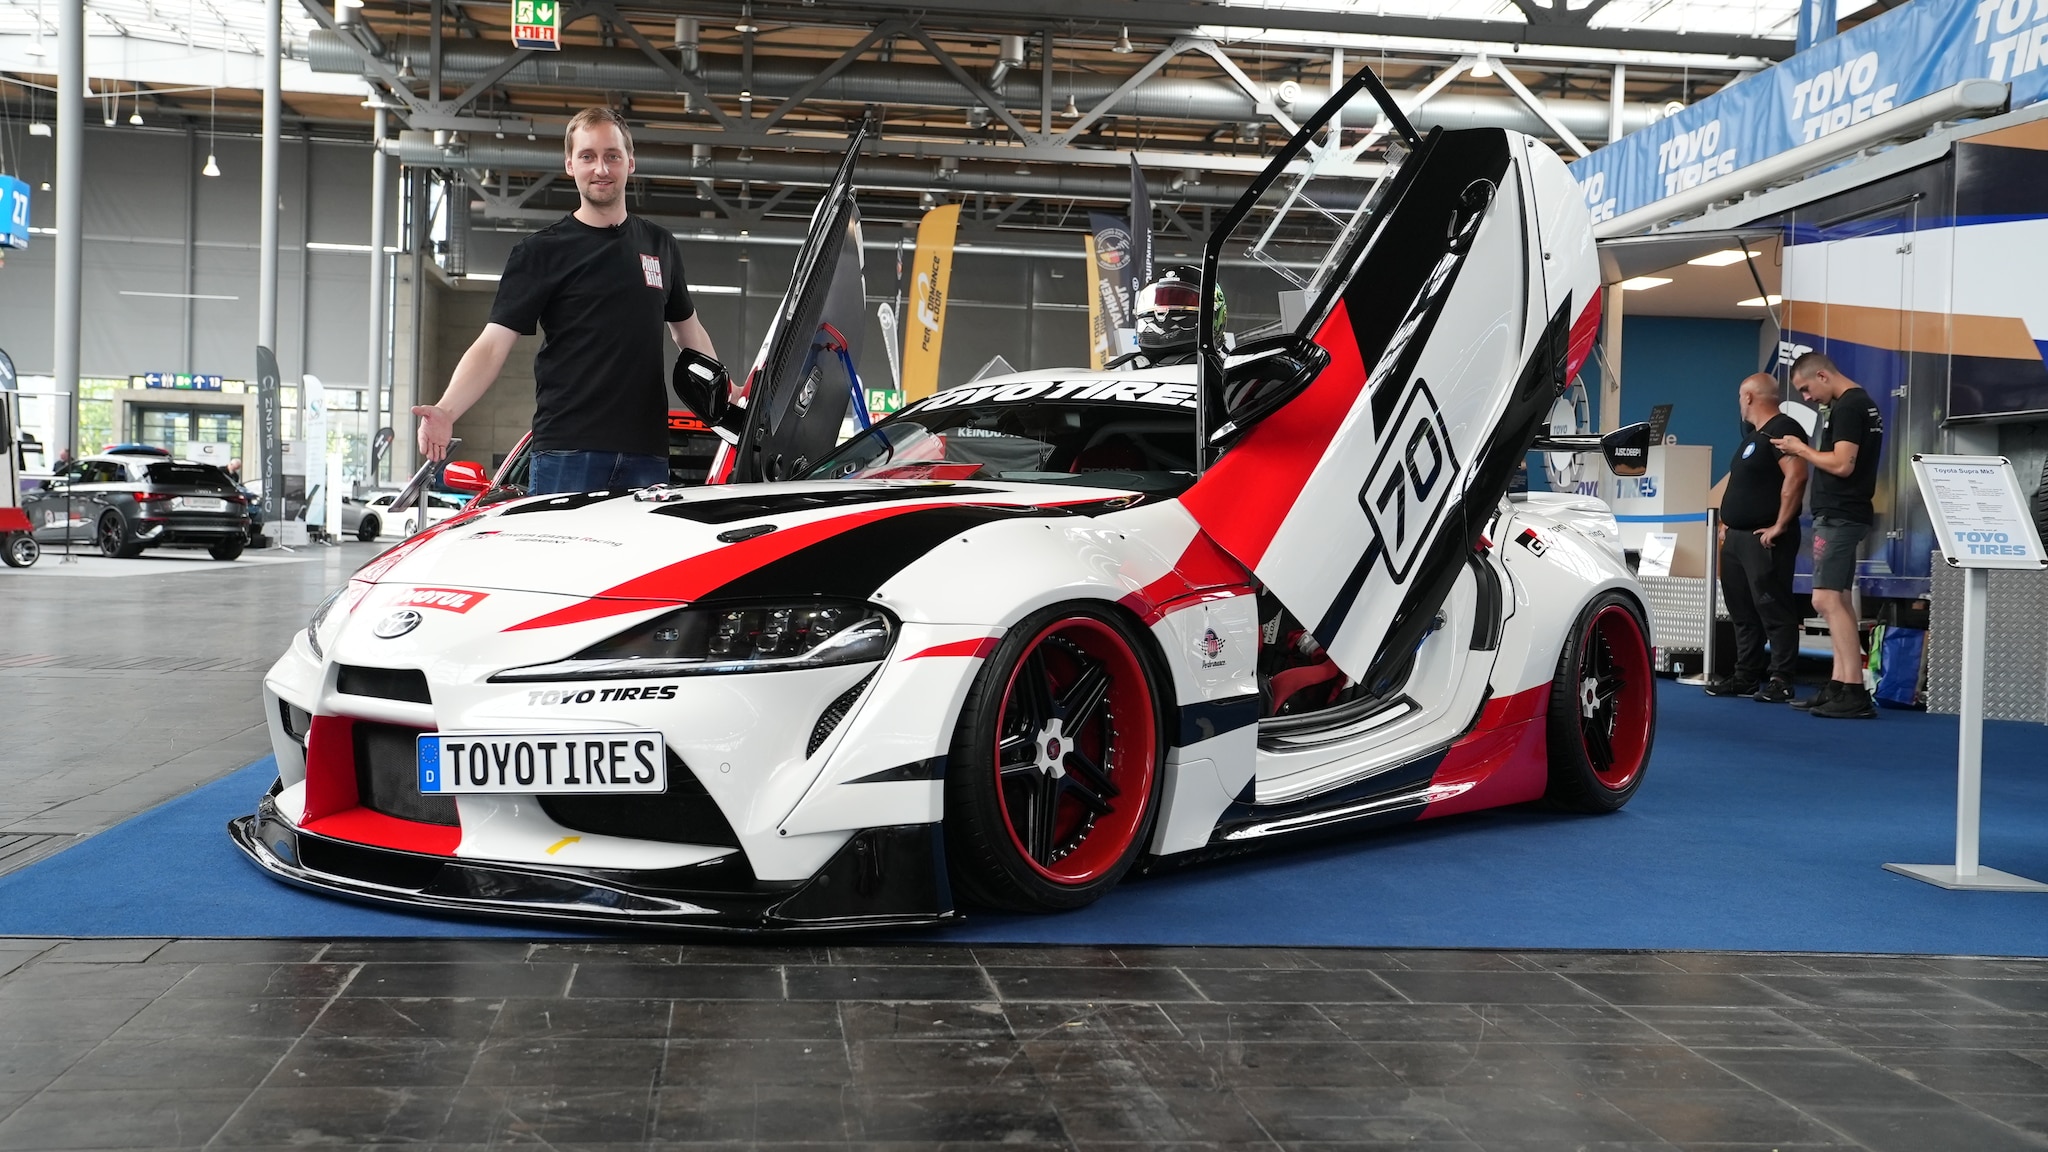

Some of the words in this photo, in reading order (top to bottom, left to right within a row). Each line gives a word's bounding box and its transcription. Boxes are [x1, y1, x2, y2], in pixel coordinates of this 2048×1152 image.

[1792, 51, 1879, 120] TOYO
[1658, 119, 1721, 175] TOYO
[12, 190, 29, 227] 27
[641, 255, 662, 273] Auto
[1145, 227, 1153, 284] QUIPMENT
[644, 270, 664, 288] Bild
[208, 376, 221, 388] 13
[264, 397, 274, 449] SKINZ
[1553, 424, 1568, 435] TOYO
[1934, 467, 1957, 475] Toyota
[264, 454, 274, 513] OMEGA
[1376, 417, 1443, 553] 70
[1616, 475, 1658, 499] TIRES
[1954, 531, 2009, 543] TOYO
[1967, 544, 2027, 556] TIRES
[528, 689, 596, 706] TOYO
[600, 685, 679, 702] TIRES
[425, 769, 436, 784] D
[446, 740, 656, 787] TOYOTIRES
